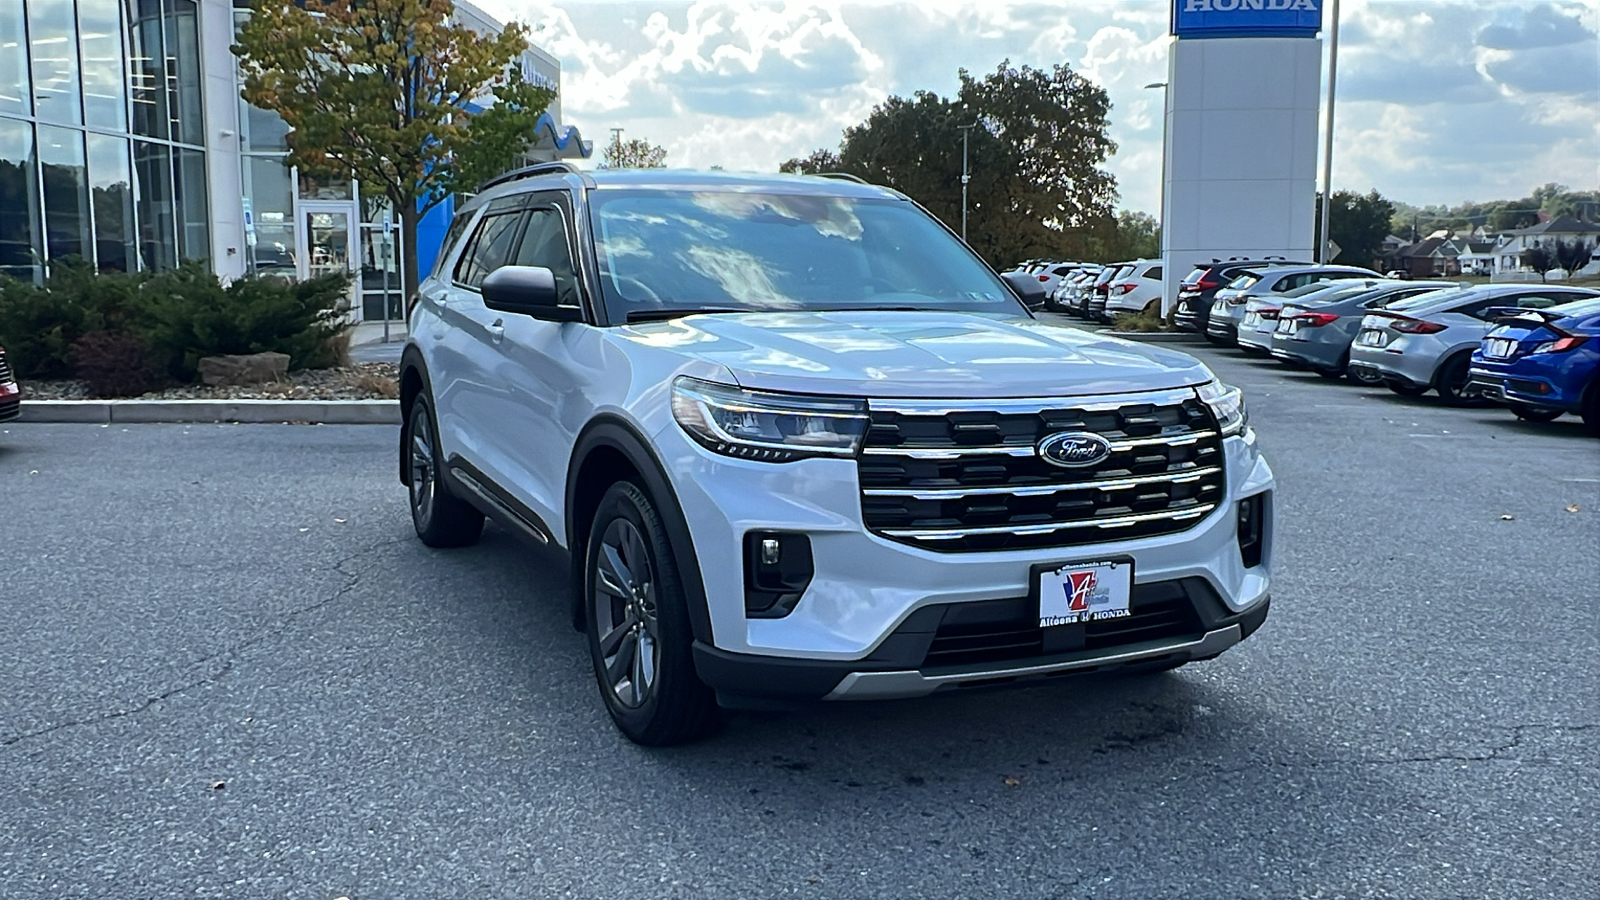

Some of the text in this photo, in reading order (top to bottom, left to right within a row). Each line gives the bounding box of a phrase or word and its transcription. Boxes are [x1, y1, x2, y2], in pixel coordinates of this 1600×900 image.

[1184, 0, 1317, 12] HONDA
[1059, 439, 1097, 460] Ford
[1040, 609, 1131, 628] Altoona HONDA
